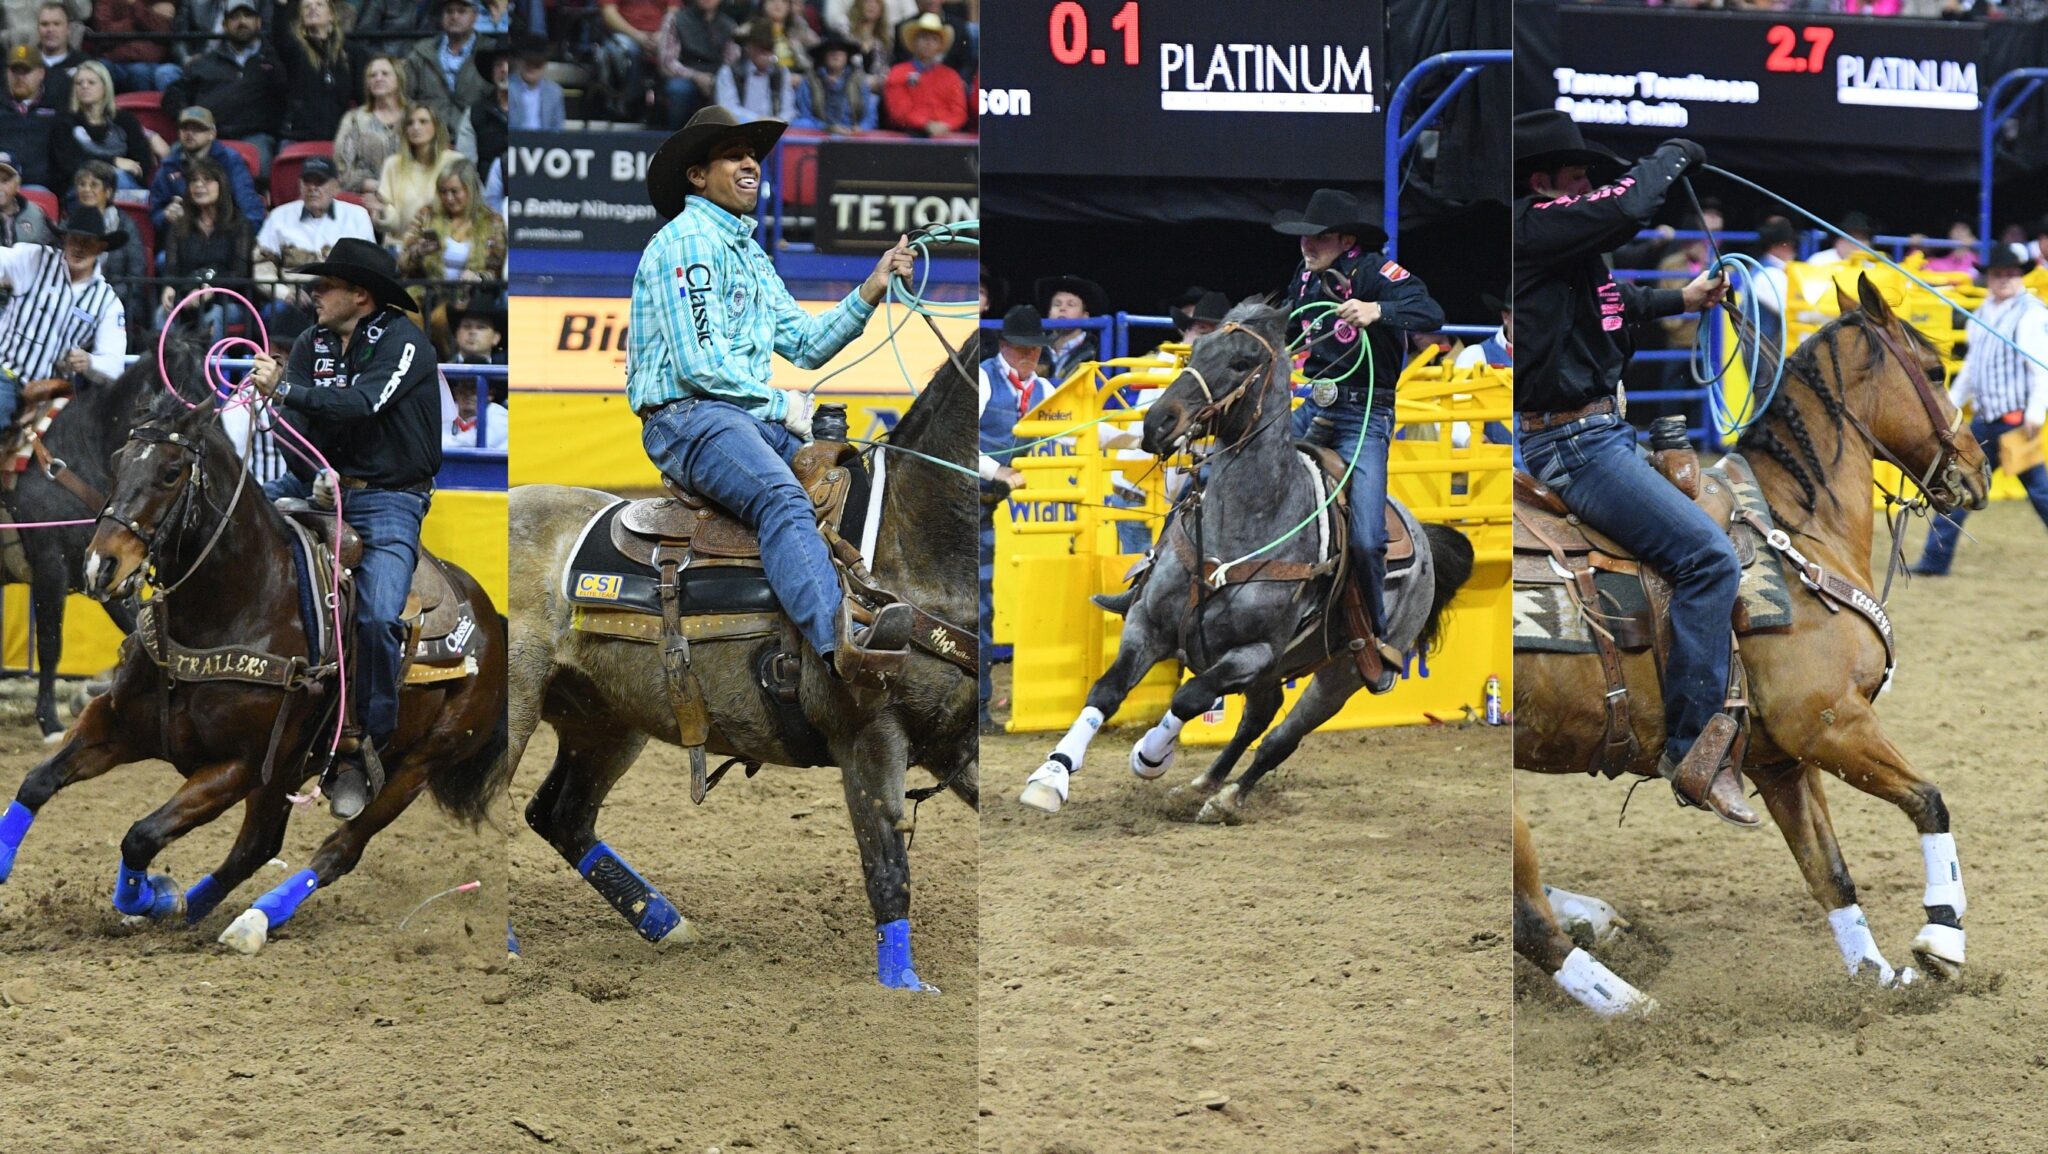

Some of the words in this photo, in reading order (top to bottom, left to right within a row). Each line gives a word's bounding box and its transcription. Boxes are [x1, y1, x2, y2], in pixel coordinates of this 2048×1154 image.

[1050, 1, 1139, 65] 0.1
[1765, 25, 1834, 74] 2.7
[1160, 43, 1373, 93] PLATINUM
[1837, 54, 1978, 93] PLATINUM
[611, 150, 656, 181] BI
[581, 199, 657, 224] Nitrogen
[830, 193, 979, 233] TETON
[685, 263, 714, 349] Classic
[580, 575, 619, 593] CSI
[176, 653, 268, 677] TRAILERS
